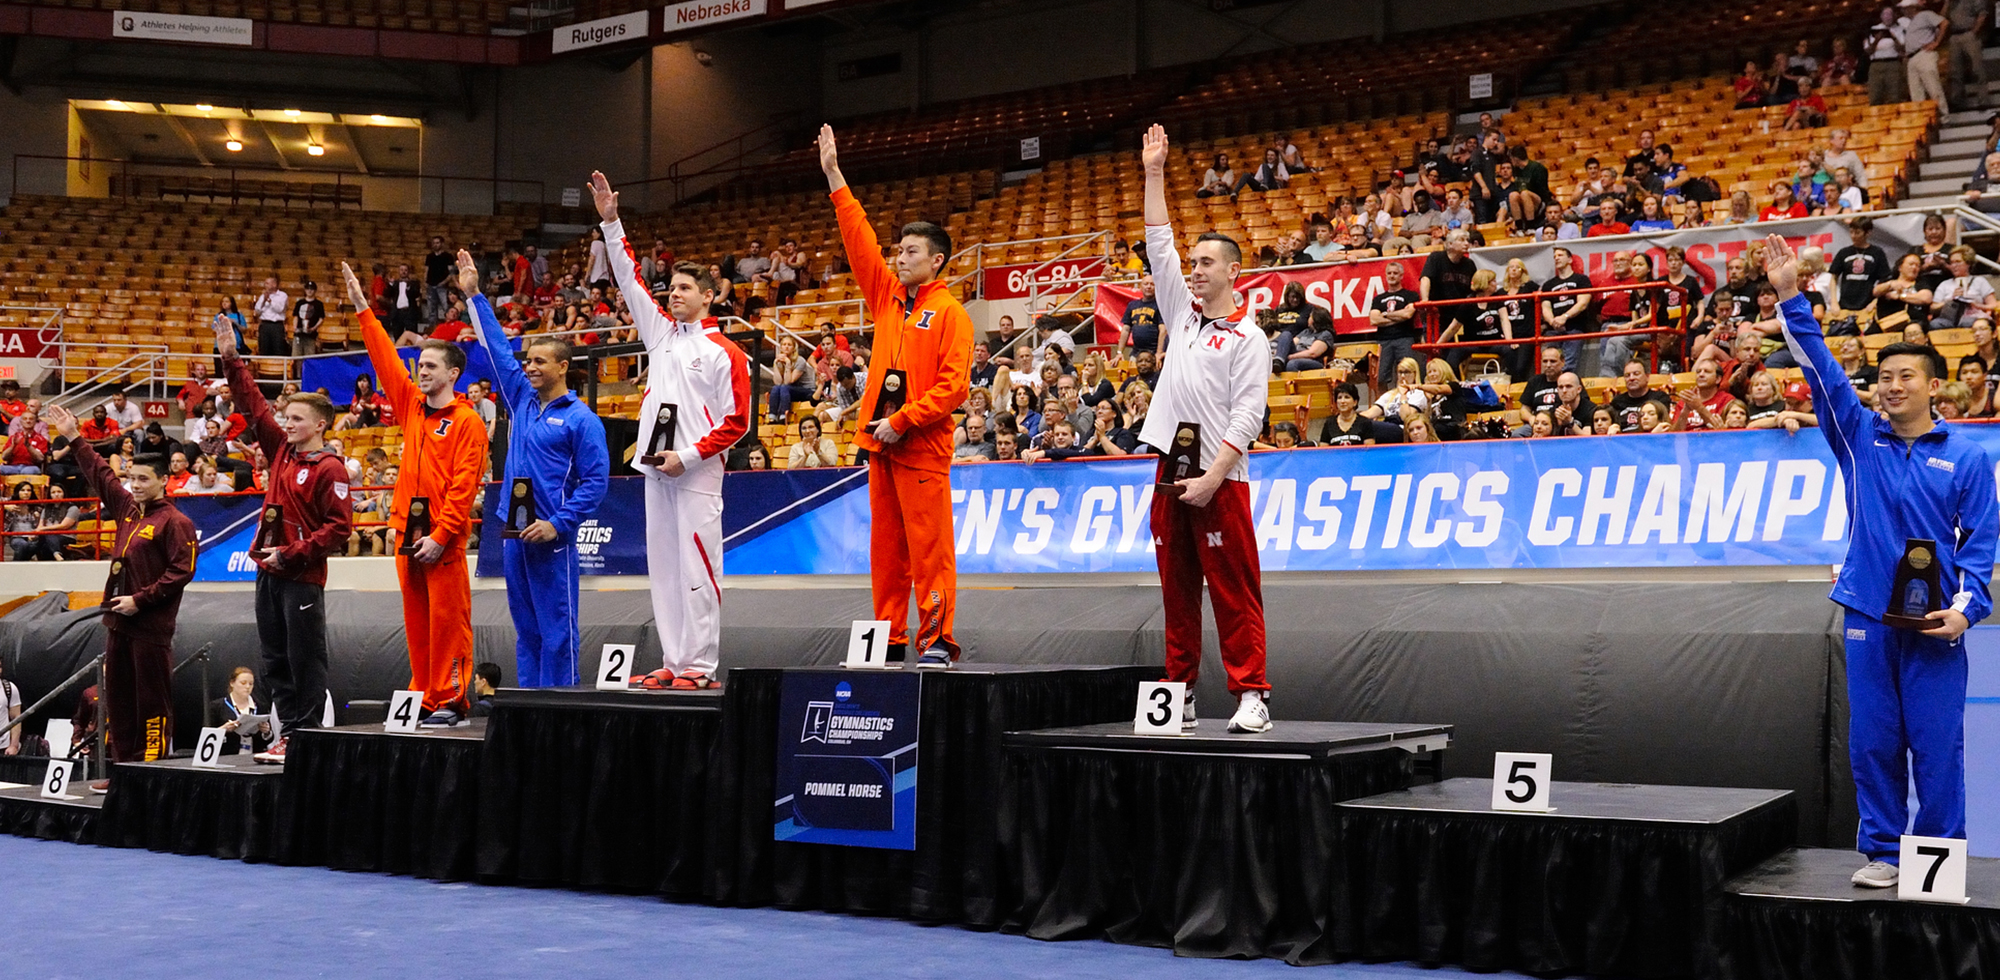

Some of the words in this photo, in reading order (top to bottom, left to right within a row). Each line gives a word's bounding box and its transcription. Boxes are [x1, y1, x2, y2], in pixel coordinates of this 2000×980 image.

[676, 0, 751, 24] Nebraska
[141, 20, 176, 30] Athletes
[178, 22, 210, 34] Helping
[212, 25, 247, 34] Athletes
[571, 22, 626, 44] Rutgers
[0, 333, 26, 354] A
[1206, 334, 1226, 351] N
[147, 404, 166, 416] 4A
[951, 487, 1060, 555] N'S
[1069, 471, 1510, 555] GYASTICS
[1527, 459, 1849, 546] CHAMPI
[576, 526, 613, 543] STICS
[1206, 531, 1223, 547] N
[227, 551, 258, 573] GYM
[862, 627, 876, 663] 1
[604, 649, 625, 683] 2
[836, 690, 852, 698] NCAA
[393, 696, 413, 727] 4
[1146, 687, 1173, 727] 3
[830, 715, 894, 731] GYMNASTICS
[828, 729, 884, 741] CHAMPIONSHIPS
[200, 733, 217, 763] 6
[48, 766, 64, 794] 8
[804, 782, 846, 797] POMMEL
[848, 784, 883, 798] HORSE
[1504, 760, 1537, 804] 5
[1916, 845, 1950, 893] 7
